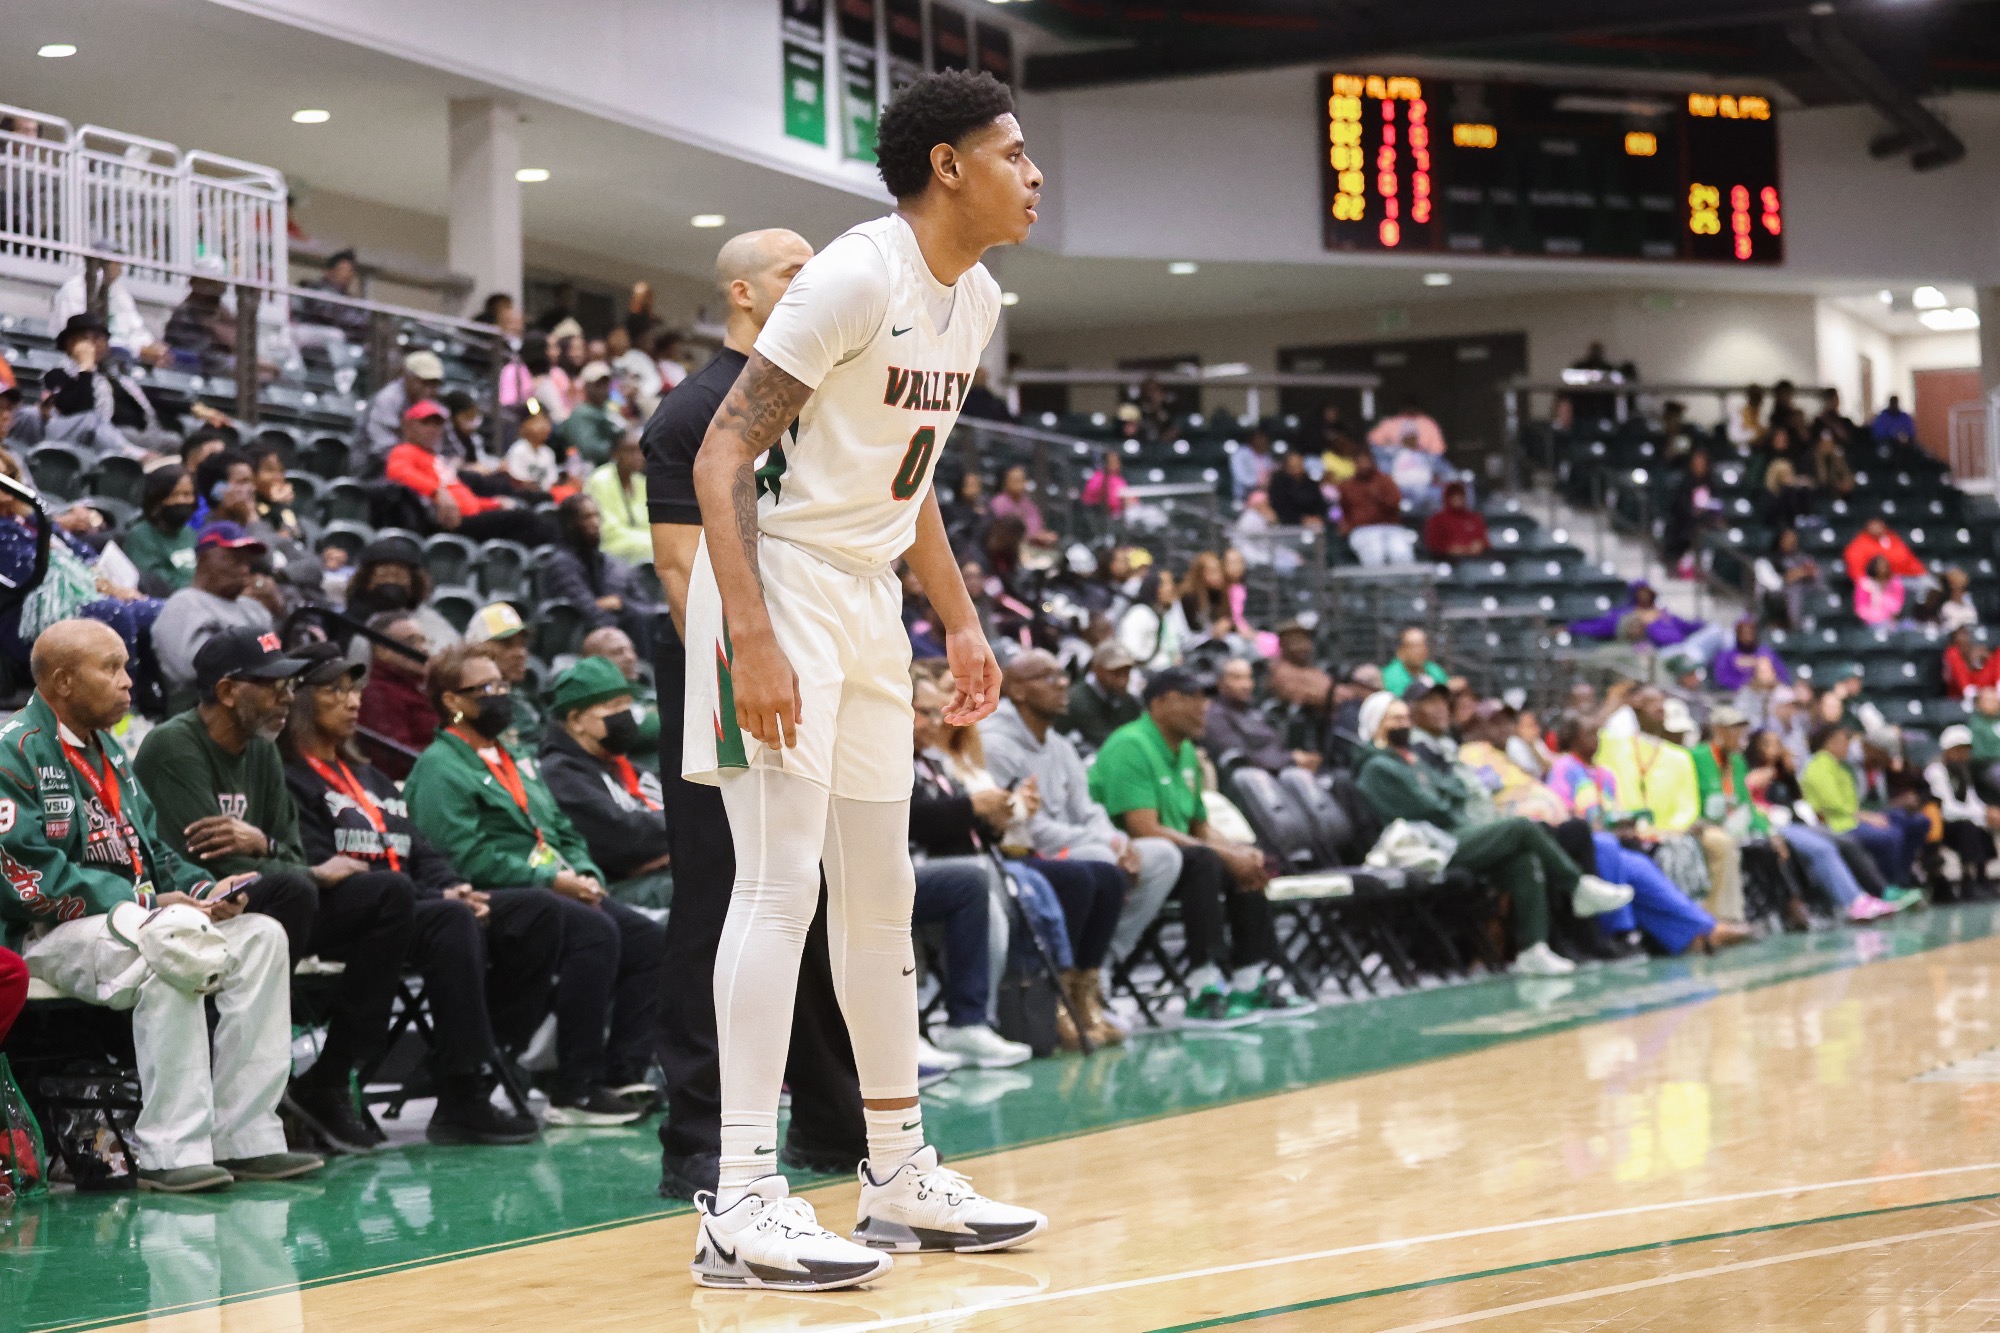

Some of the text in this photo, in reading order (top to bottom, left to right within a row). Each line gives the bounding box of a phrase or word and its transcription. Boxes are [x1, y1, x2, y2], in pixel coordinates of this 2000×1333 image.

[883, 365, 971, 412] VALLEY
[891, 426, 936, 501] 0
[45, 801, 69, 812] VSU
